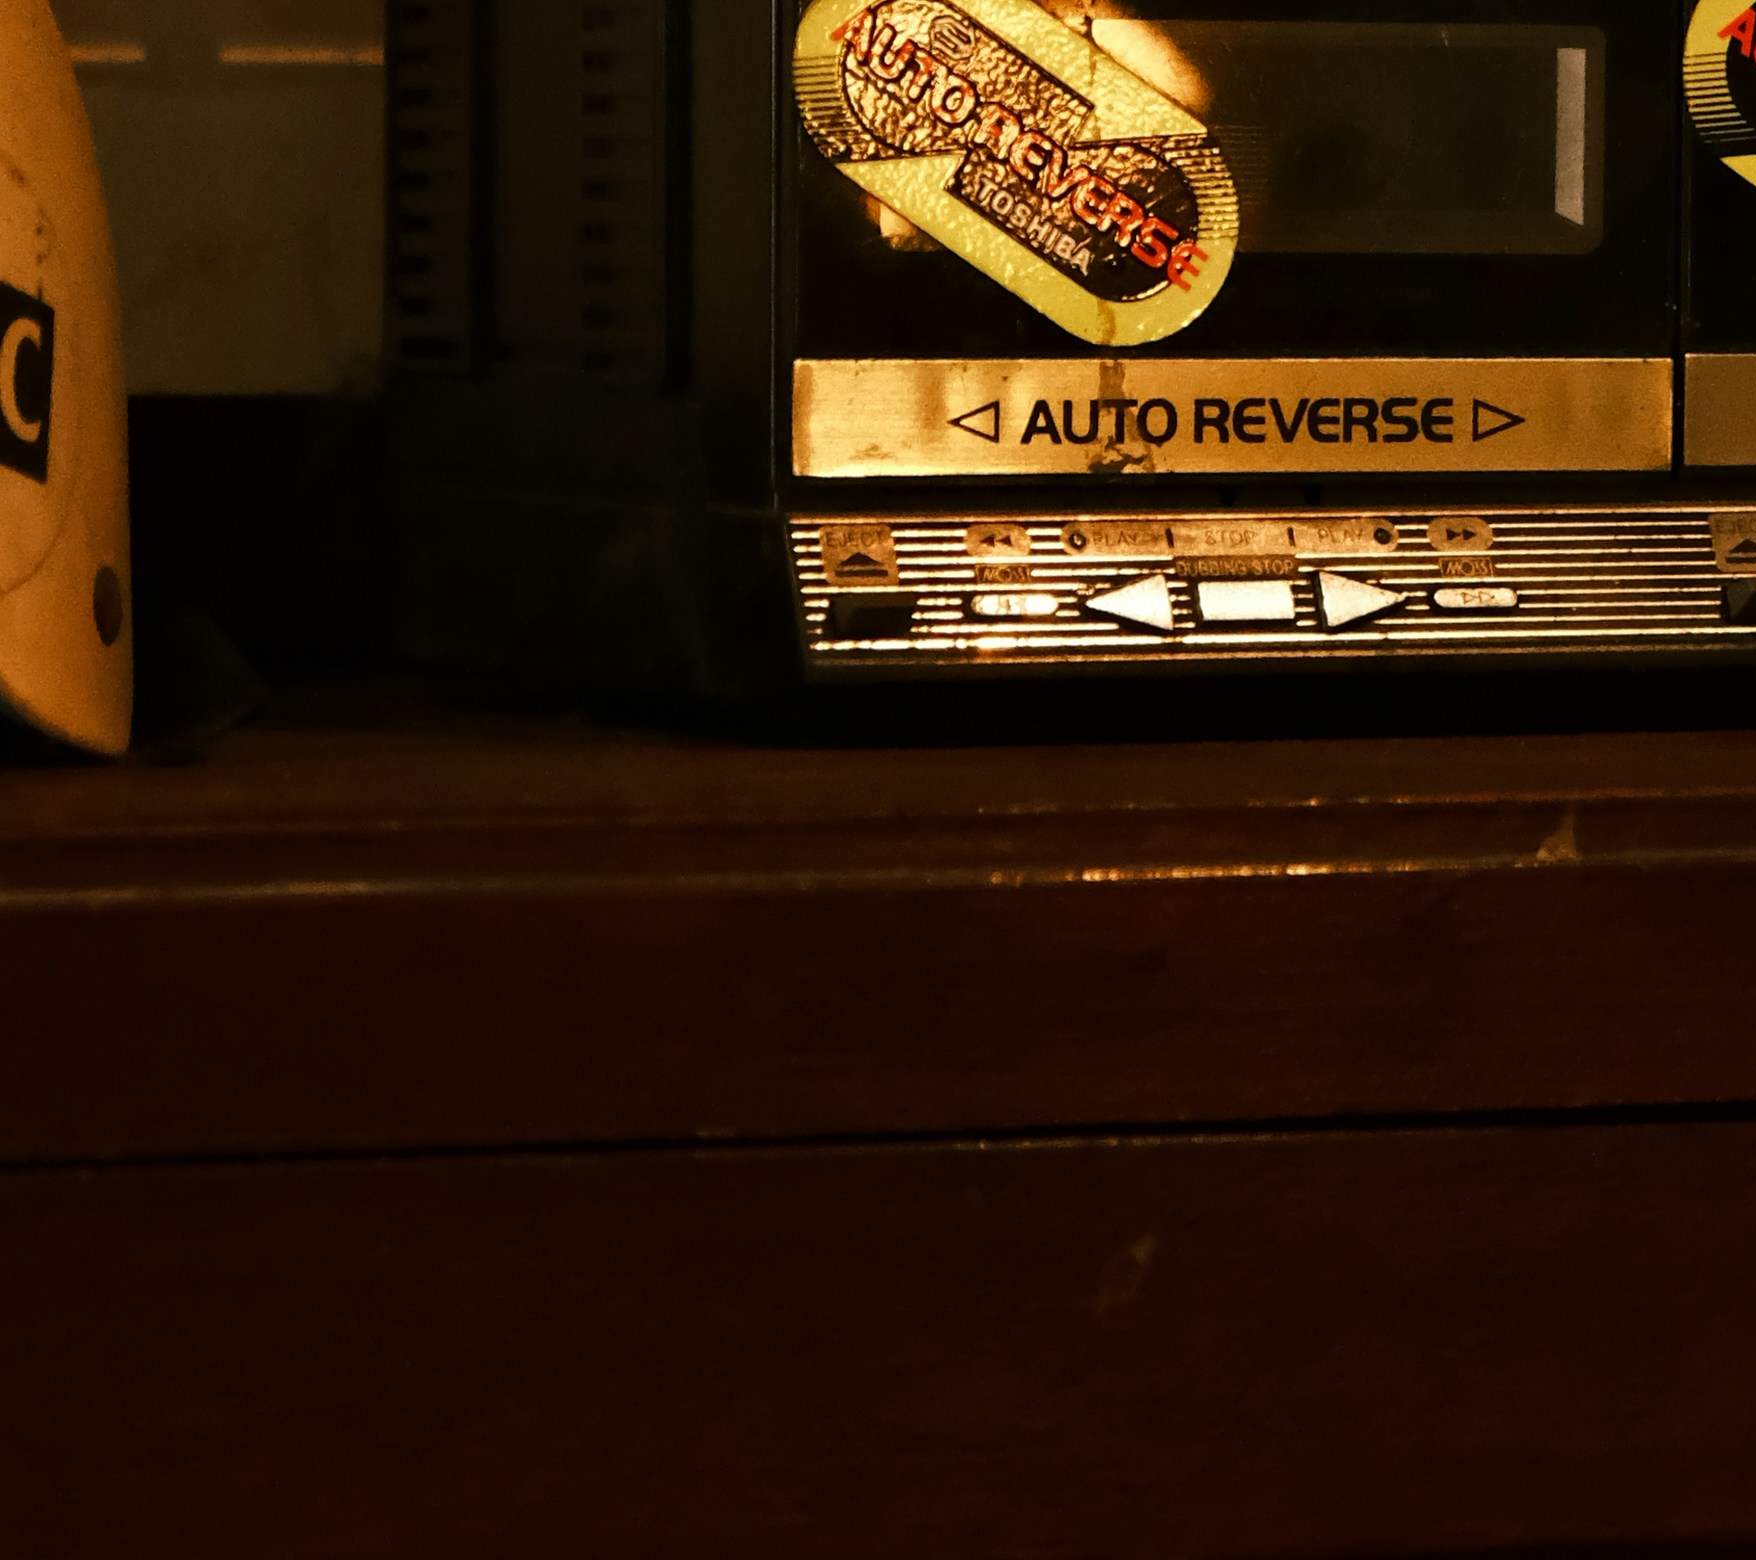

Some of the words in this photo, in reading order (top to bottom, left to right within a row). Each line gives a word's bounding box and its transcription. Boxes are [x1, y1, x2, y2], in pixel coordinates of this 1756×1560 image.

[830, 9, 977, 126] AUTO
[966, 102, 1209, 293] REVERSE
[977, 178, 1093, 276] TOSHIBA
[0, 317, 43, 443] C
[1020, 398, 1178, 446] AUTO
[1194, 398, 1455, 443] REVERSE
[825, 530, 884, 547] EJECT
[1204, 530, 1255, 545] STOP
[1317, 528, 1364, 543] PLAY
[1175, 560, 1247, 577] DUBBING
[1250, 559, 1295, 576] STOP
